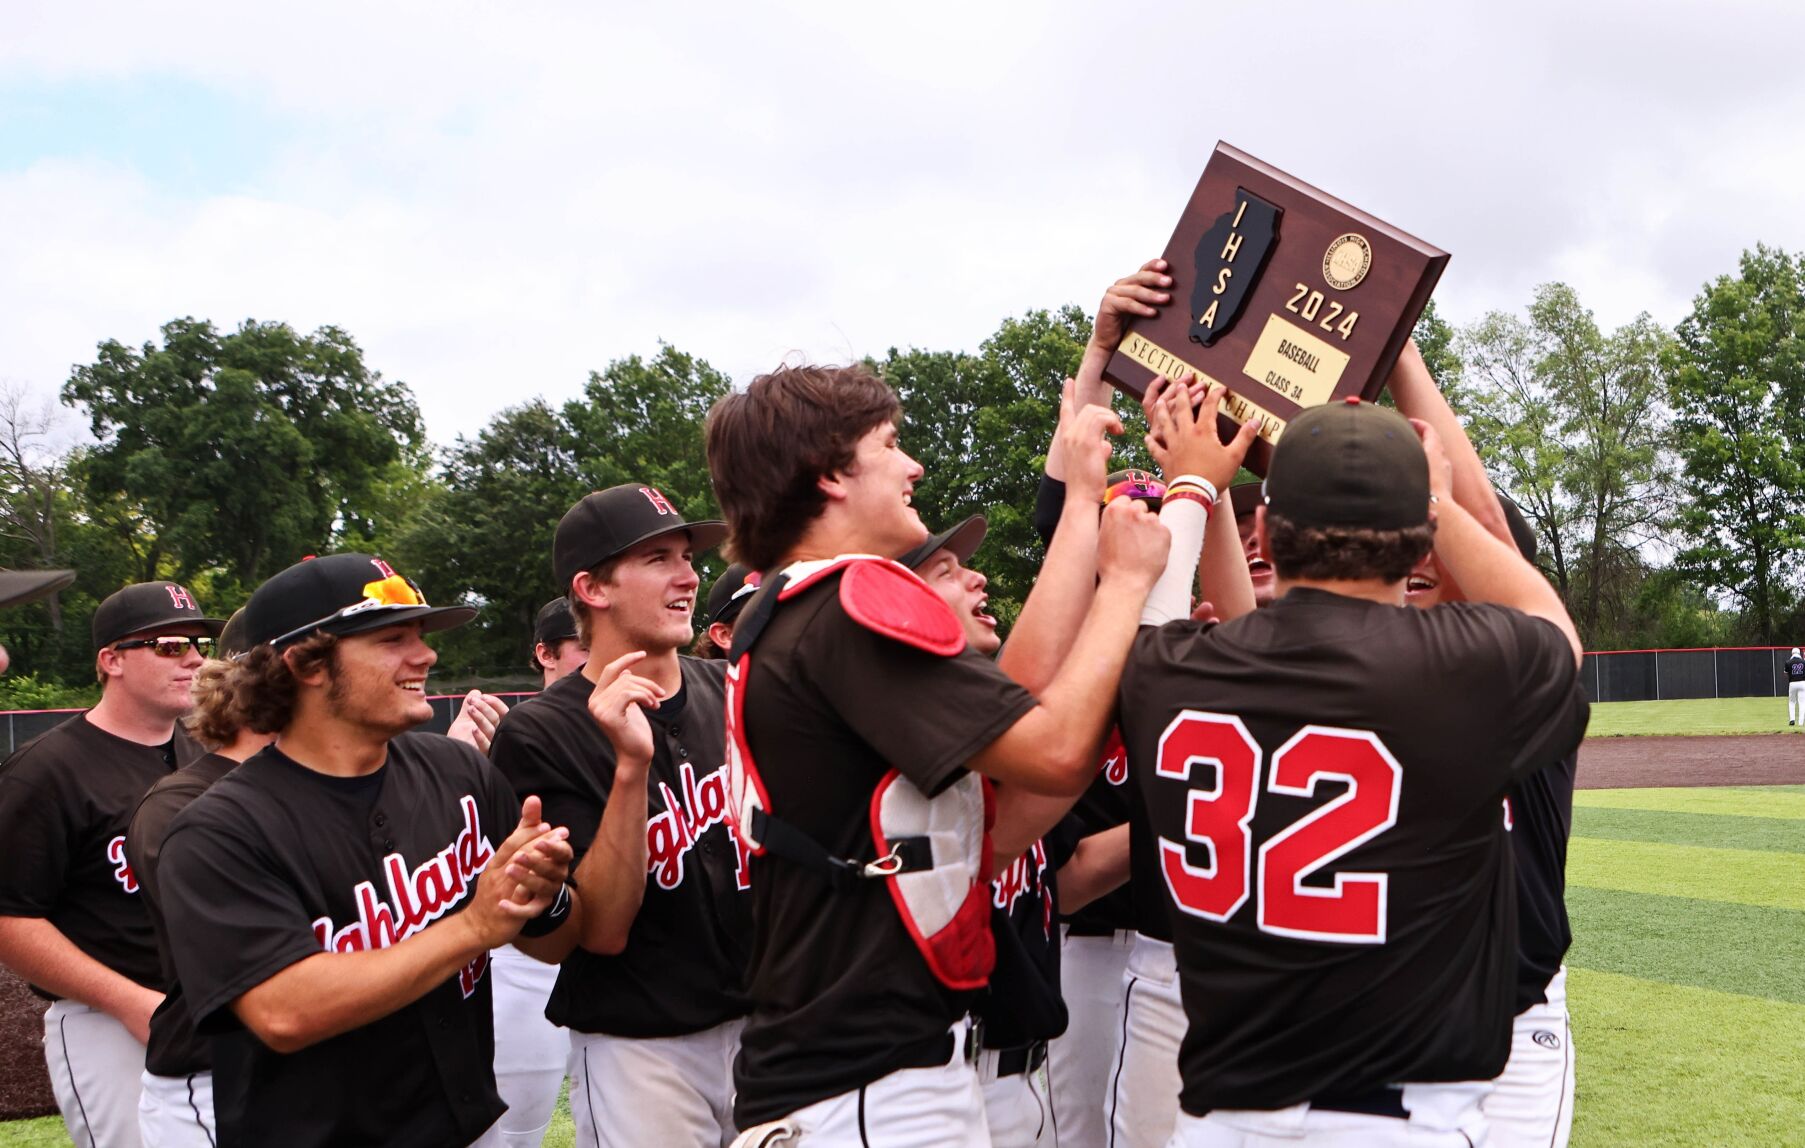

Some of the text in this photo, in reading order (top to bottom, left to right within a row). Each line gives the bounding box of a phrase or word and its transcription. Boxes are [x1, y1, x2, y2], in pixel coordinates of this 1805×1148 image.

[1199, 200, 1247, 329] IHSA
[1285, 282, 1359, 341] 2024
[1277, 338, 1320, 374] BASEBALL
[1265, 370, 1304, 401] CLASS 3A
[639, 487, 679, 516] H
[165, 585, 196, 611] H
[1156, 709, 1403, 944] 32
